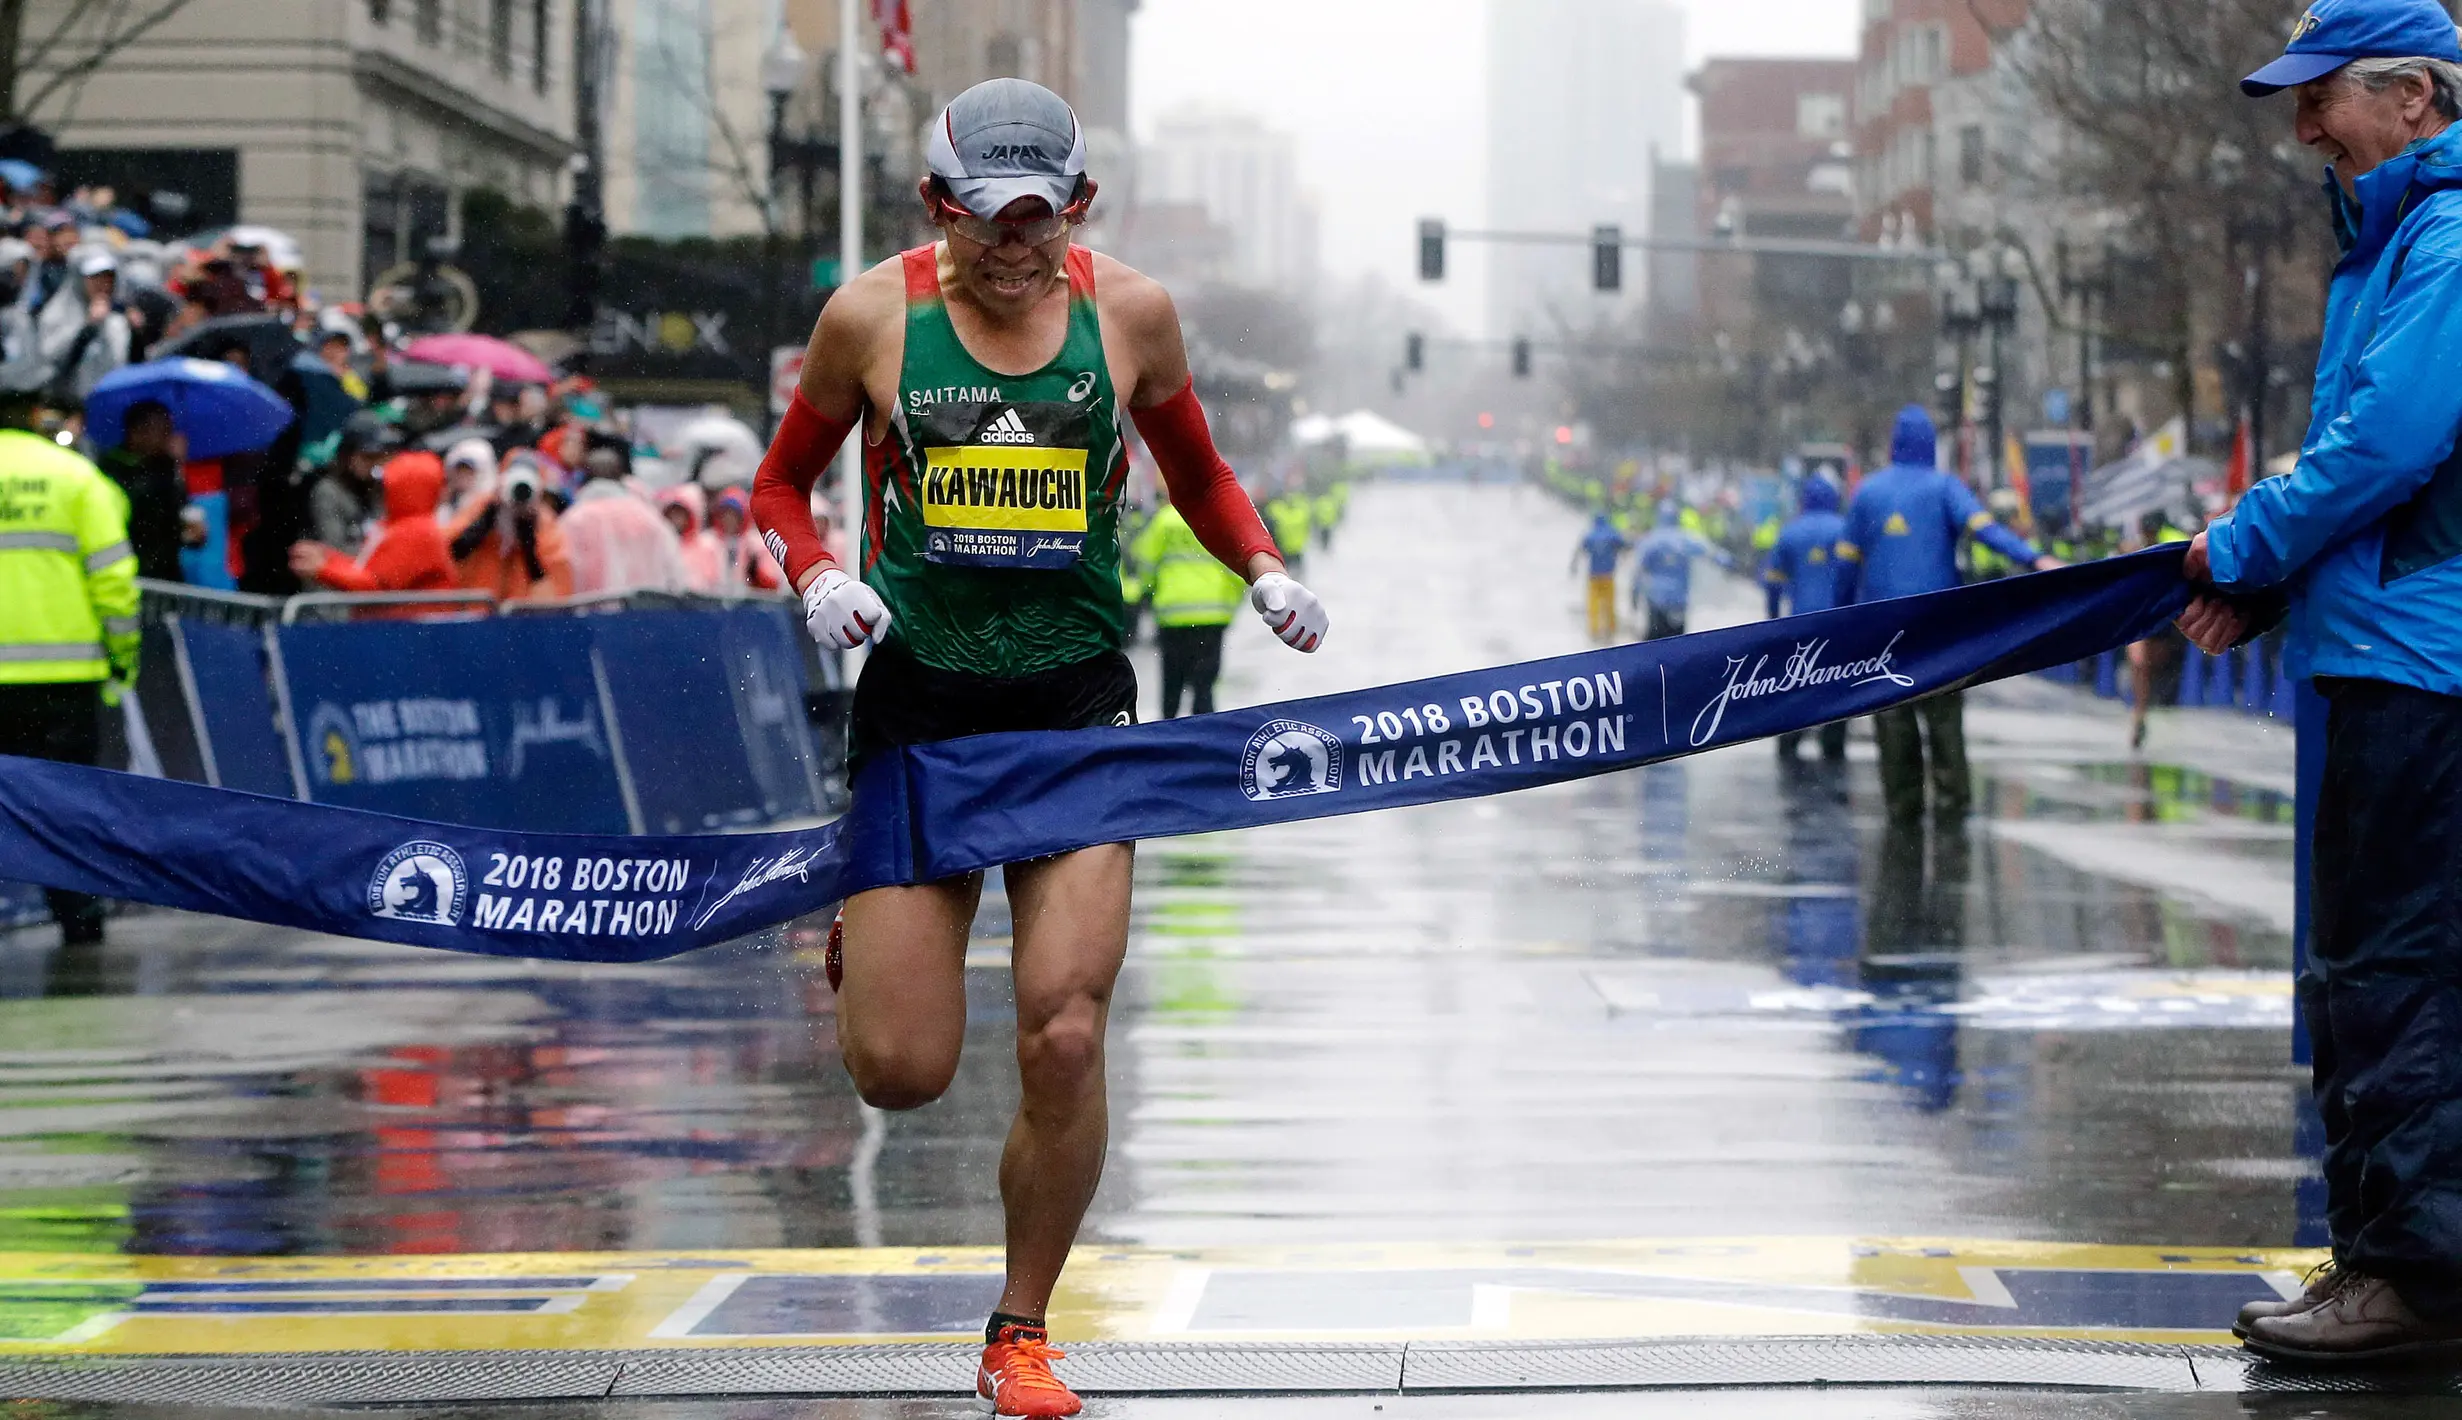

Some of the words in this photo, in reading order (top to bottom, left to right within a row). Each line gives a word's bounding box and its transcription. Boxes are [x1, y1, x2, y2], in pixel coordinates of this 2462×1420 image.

[982, 145, 1051, 160] JAPAN
[909, 386, 1002, 408] SAITAMA
[980, 431, 1035, 444] adidas
[927, 466, 1082, 510] KAWAUCHI
[953, 533, 975, 544] 2018
[978, 535, 1017, 545] BOSTON
[953, 544, 1017, 556] MARATHON
[1351, 703, 1450, 744] 2018
[1459, 671, 1623, 729] BOSTON
[1690, 653, 1780, 746] John
[1775, 629, 1914, 692] Hancock
[1243, 749, 1258, 795] BOSTON
[1252, 721, 1299, 750] ATHLETIC
[1300, 725, 1340, 785] ASSOCIATION
[1358, 714, 1625, 787] MARATHON
[371, 864, 391, 909] BOSTON
[388, 844, 442, 867] ATHLETIC
[483, 852, 563, 890] 2018
[571, 857, 690, 893] BOSTON
[472, 893, 678, 937] MARATHON
